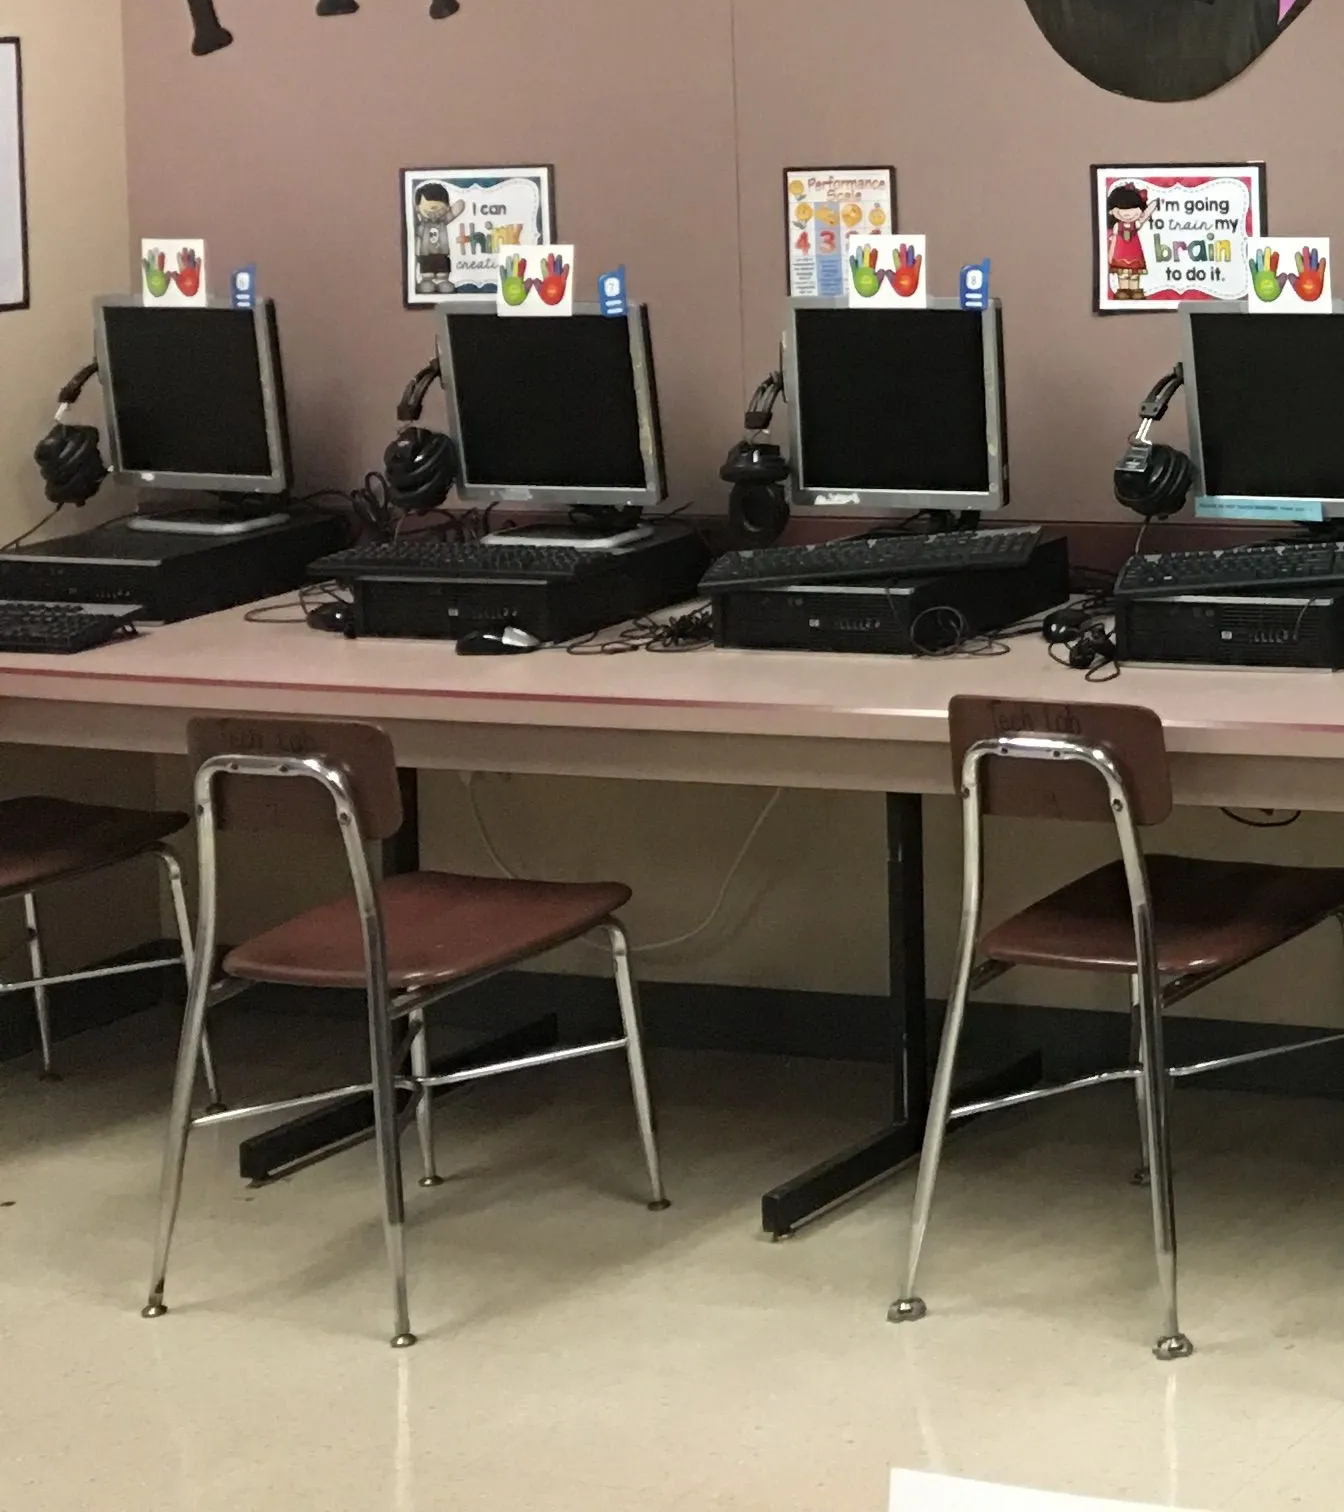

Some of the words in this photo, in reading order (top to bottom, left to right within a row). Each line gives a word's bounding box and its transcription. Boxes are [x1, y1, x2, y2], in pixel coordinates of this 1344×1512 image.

[807, 175, 886, 190] Performance
[480, 202, 507, 215] can
[1184, 198, 1230, 215] going
[1148, 217, 1165, 231] to
[1168, 217, 1214, 231] train
[1215, 218, 1239, 233] my
[819, 230, 836, 254] 3
[1153, 232, 1232, 264] brain
[1165, 267, 1182, 282] to
[1185, 267, 1205, 282] do
